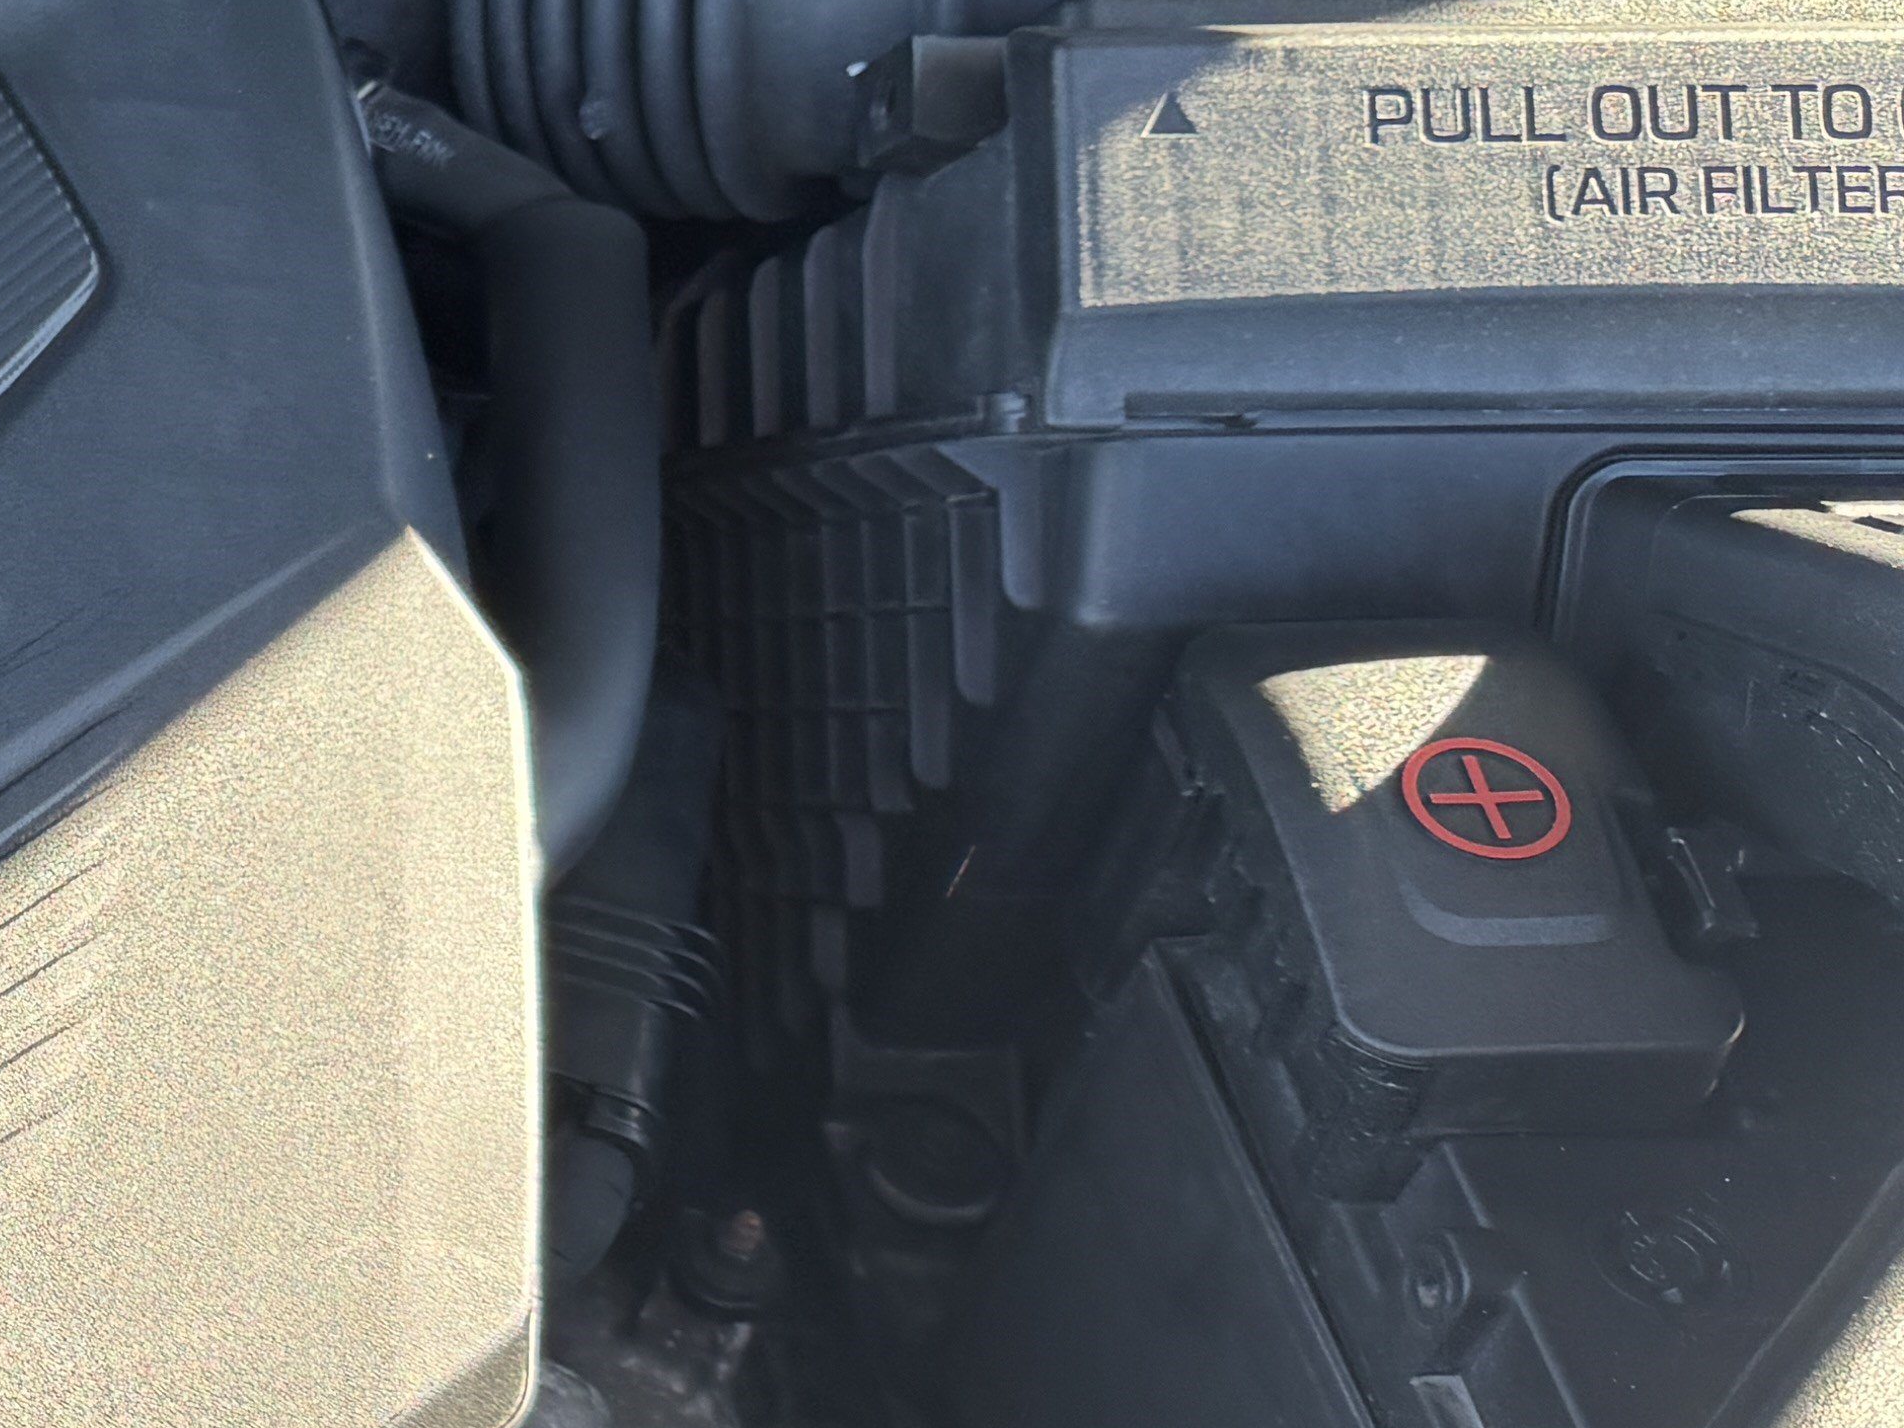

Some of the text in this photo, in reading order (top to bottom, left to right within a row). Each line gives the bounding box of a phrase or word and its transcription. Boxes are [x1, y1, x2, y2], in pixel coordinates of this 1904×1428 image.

[1366, 84, 1567, 145] PULL
[1592, 83, 1748, 142] OUT
[1769, 83, 1873, 141] TO
[1545, 164, 1681, 223] (AIR
